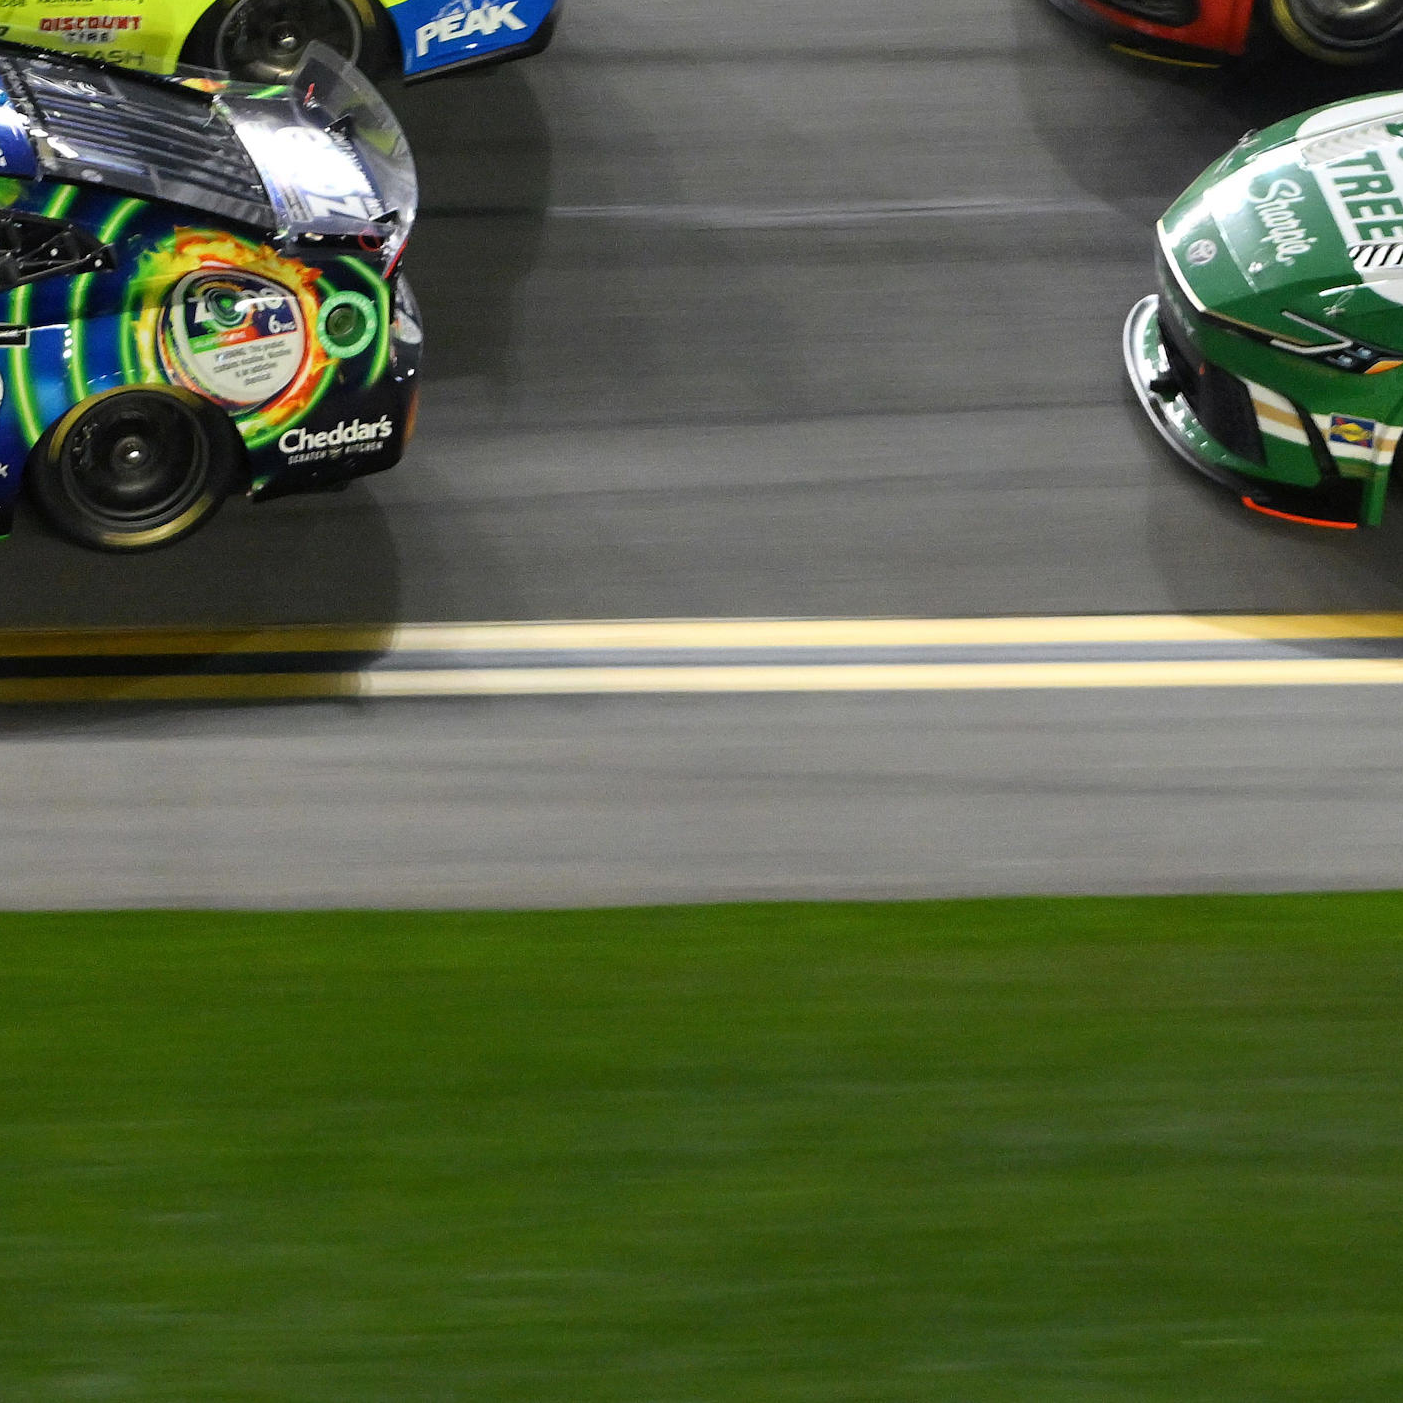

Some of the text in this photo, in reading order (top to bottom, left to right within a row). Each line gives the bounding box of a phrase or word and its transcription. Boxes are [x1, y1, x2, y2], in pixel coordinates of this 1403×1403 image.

[39, 16, 143, 31] DISCOUNT
[415, 0, 529, 56] PEAK
[1248, 178, 1311, 263] Sharpie
[278, 414, 393, 453] Cheddar's
